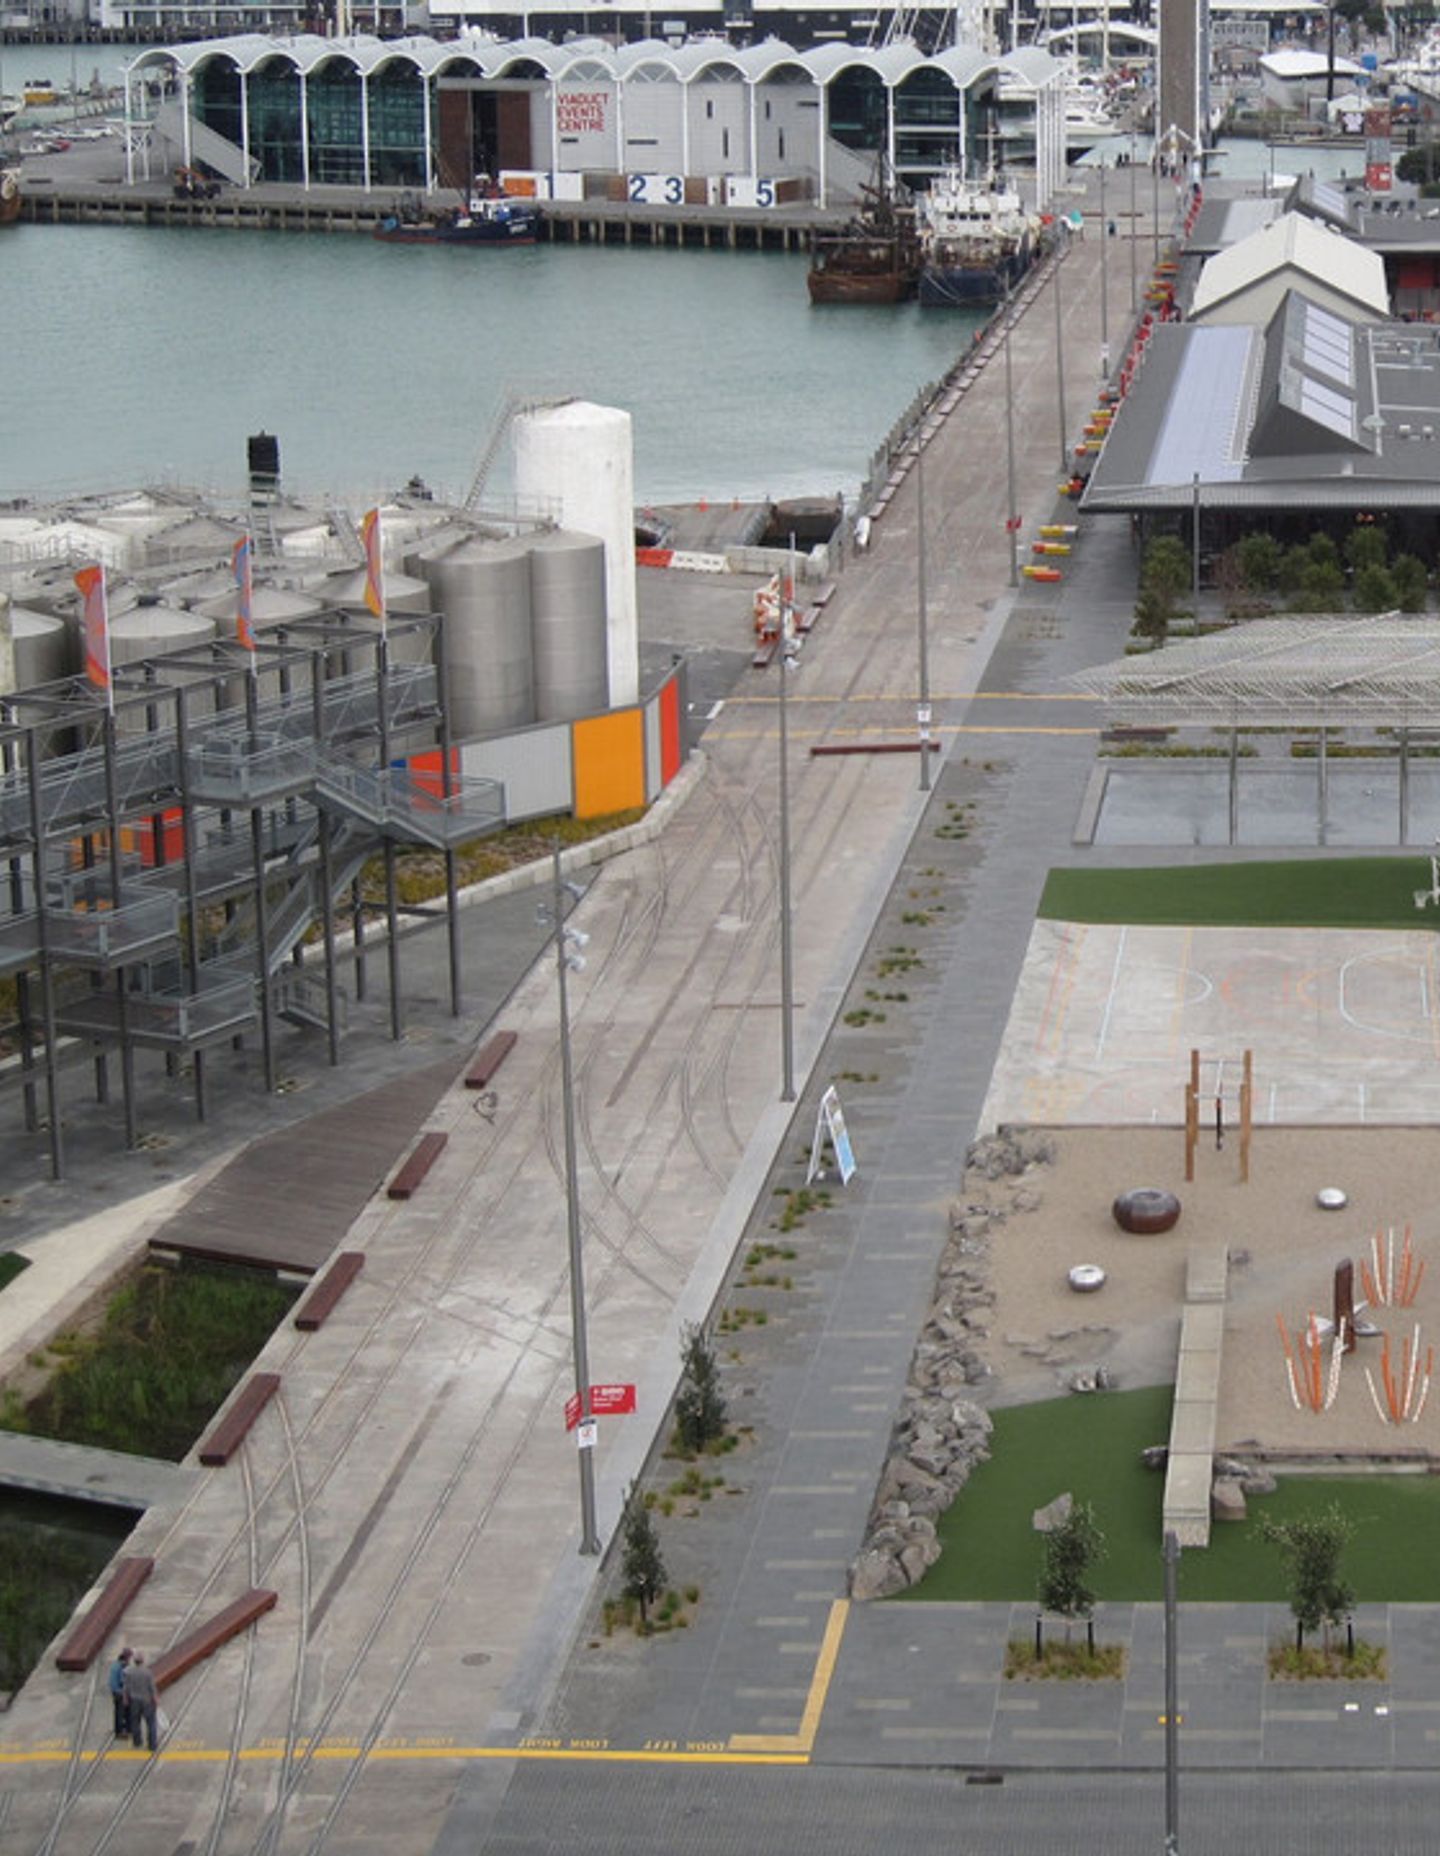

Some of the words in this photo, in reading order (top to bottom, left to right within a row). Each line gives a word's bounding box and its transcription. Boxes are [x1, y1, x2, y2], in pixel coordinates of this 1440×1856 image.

[558, 93, 608, 105] VIADUCT
[558, 106, 604, 118] EVENTS
[558, 119, 605, 132] CENTRE
[629, 175, 647, 203] 2
[665, 176, 683, 203] 3
[756, 180, 774, 207] 5
